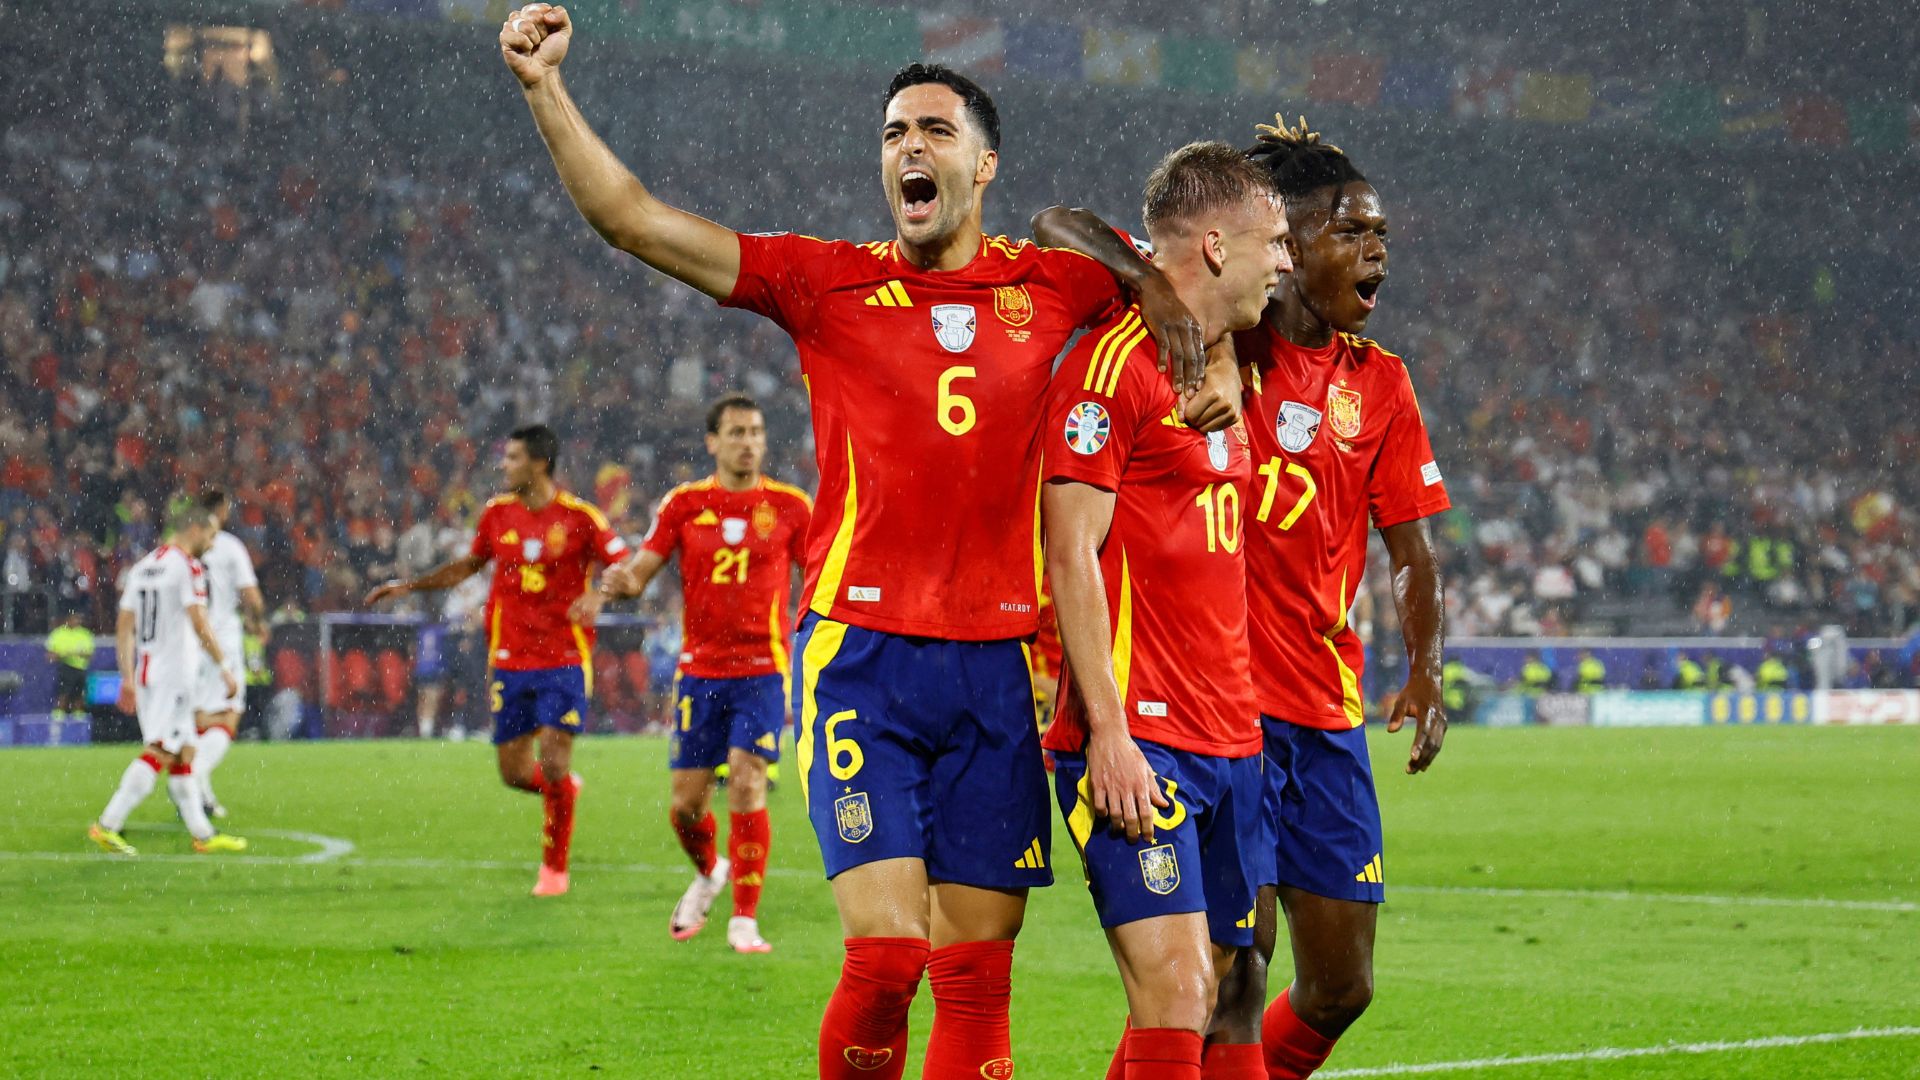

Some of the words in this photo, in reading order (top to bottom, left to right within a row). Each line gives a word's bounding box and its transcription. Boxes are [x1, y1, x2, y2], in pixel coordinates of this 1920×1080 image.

[937, 365, 977, 436] 6
[1195, 482, 1239, 554] 10
[1256, 455, 1317, 531] 17
[518, 563, 546, 594] 16
[711, 547, 750, 584] 21
[824, 708, 864, 781] 6
